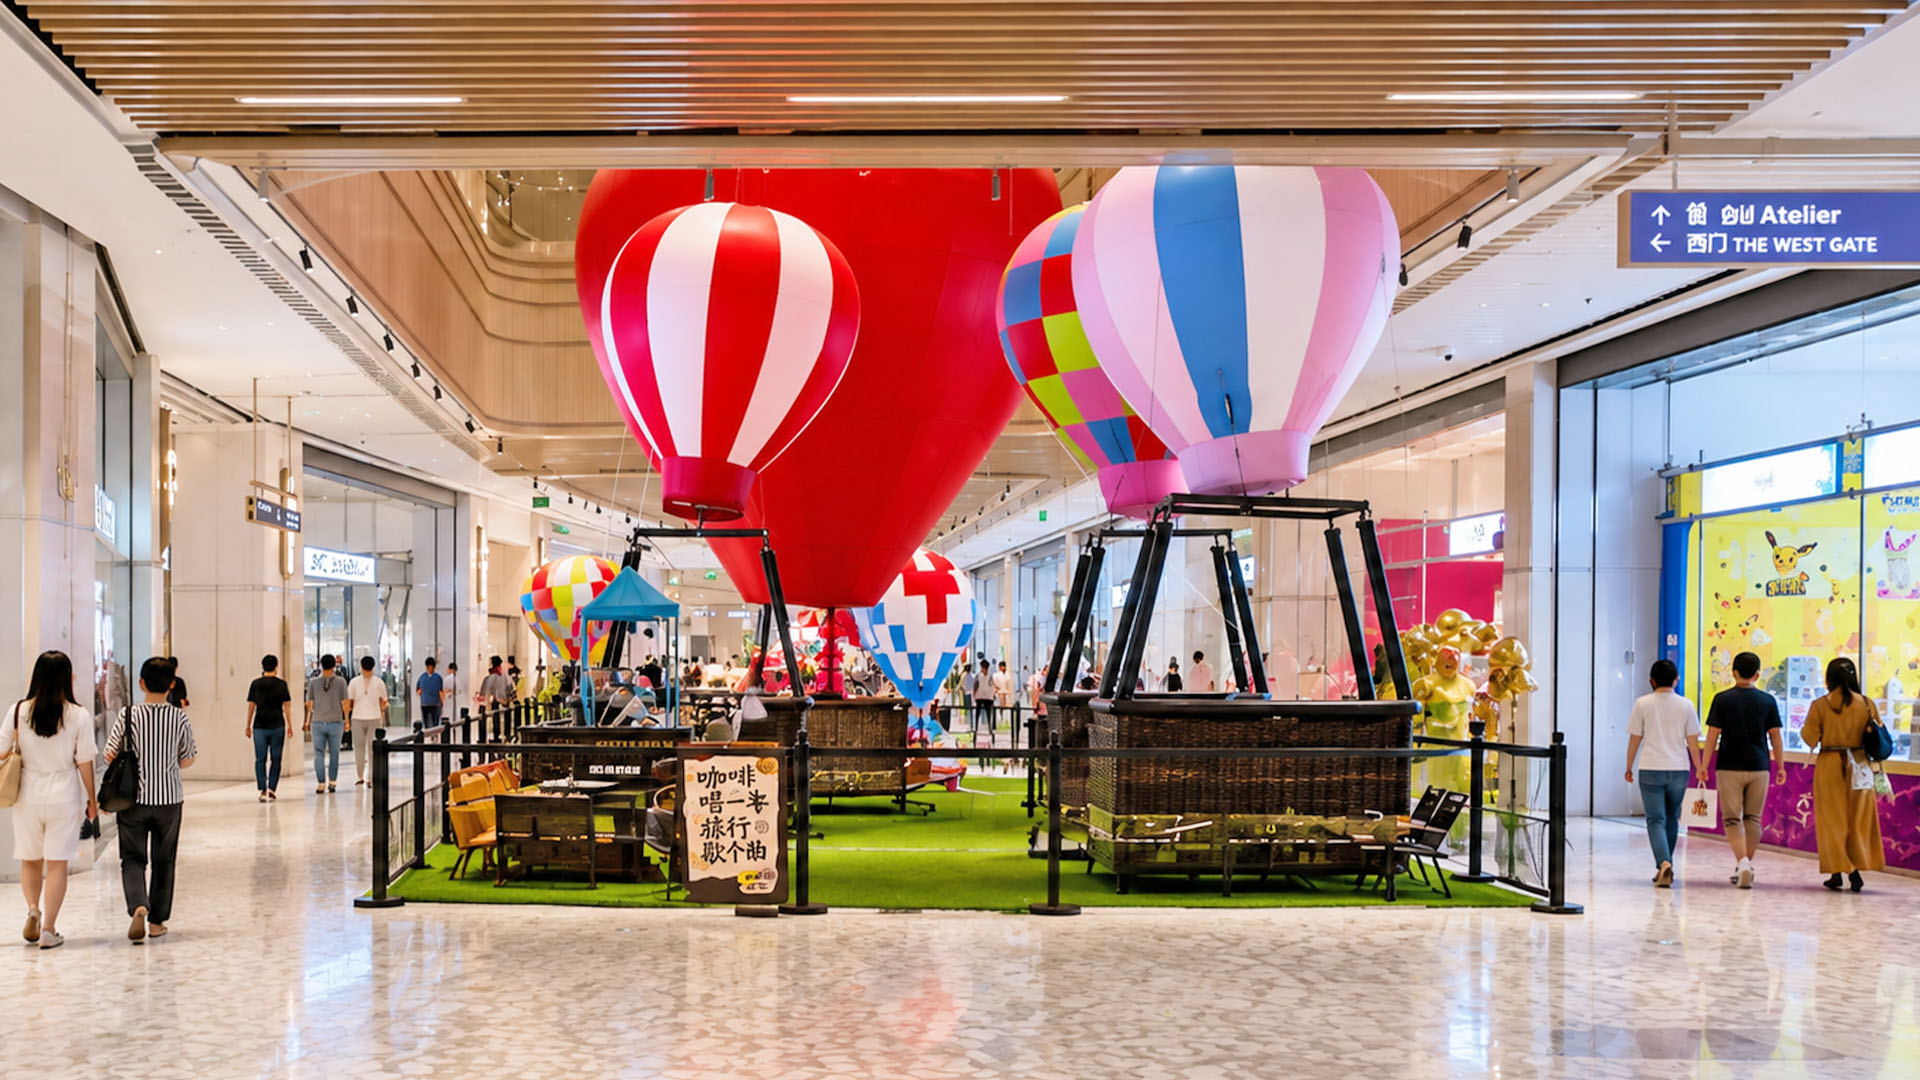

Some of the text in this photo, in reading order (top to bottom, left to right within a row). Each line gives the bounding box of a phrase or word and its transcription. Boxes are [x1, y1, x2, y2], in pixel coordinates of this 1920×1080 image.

[1760, 205, 1842, 225] Atelier
[1686, 232, 1728, 254] 西门
[1732, 237, 1878, 253] THE WEST GATE
[697, 764, 756, 789] 咖啡
